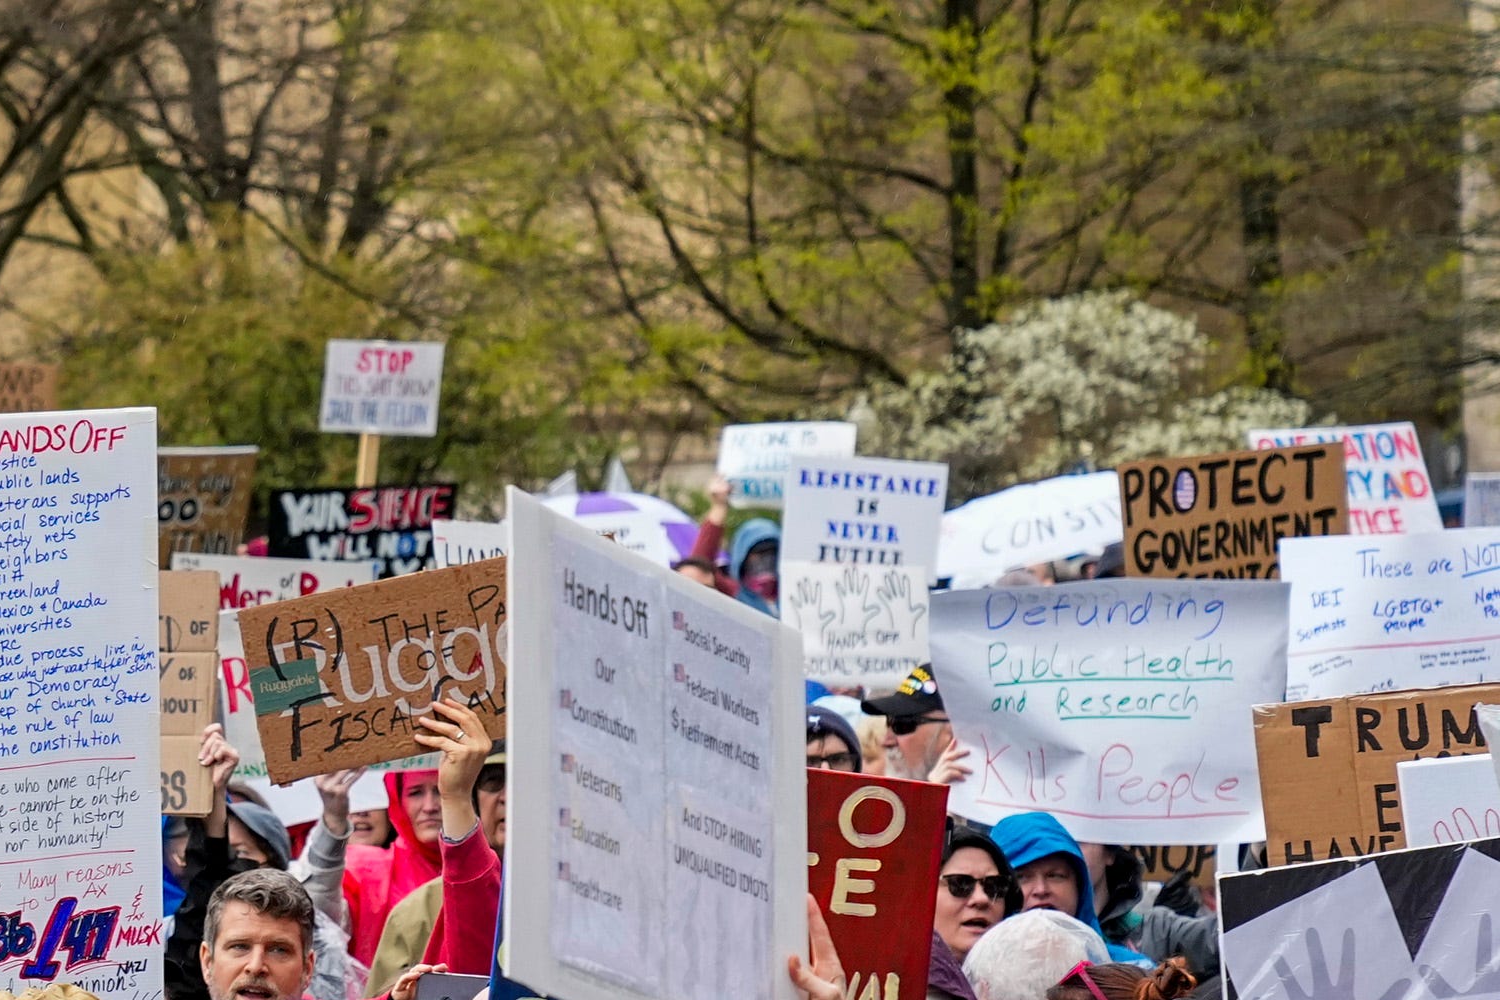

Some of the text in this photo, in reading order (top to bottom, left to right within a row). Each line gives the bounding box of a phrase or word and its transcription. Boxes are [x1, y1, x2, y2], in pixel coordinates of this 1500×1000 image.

[357, 348, 414, 374] STOP
[69, 419, 127, 454] OFF
[40, 467, 81, 486] lands
[799, 468, 941, 498] RESISTANCE
[1122, 449, 1327, 528] PROTECT
[70, 484, 131, 511] supports
[855, 498, 880, 517] IS
[279, 491, 350, 537] YOUR
[44, 527, 77, 544] nets
[378, 530, 432, 558] NOT
[826, 519, 901, 544] NEVER
[1133, 507, 1339, 574] GOVERNMENT
[1356, 548, 1413, 579] These
[1427, 558, 1455, 575] are
[279, 571, 297, 591] of
[53, 592, 108, 614] Canada
[564, 566, 649, 640] Hands Off
[1310, 587, 1345, 609] DEI
[1372, 599, 1445, 618] LGBTQ+
[189, 619, 211, 636] OF
[984, 590, 1227, 641] Defunding
[369, 610, 455, 653] THE
[827, 629, 901, 651] HANDS OFF
[31, 645, 85, 667] process
[416, 645, 456, 672] OF
[683, 622, 751, 675] Social Security
[987, 640, 1235, 682] Public Health
[178, 666, 198, 682] OR
[594, 656, 617, 684] Our
[856, 654, 922, 677] SECURITY
[27, 674, 121, 698] Democracy
[258, 672, 318, 694] Ruggable
[26, 698, 46, 715] of
[51, 694, 97, 712] church
[684, 673, 760, 727] Federal Workers
[990, 685, 1201, 715] and Research
[25, 718, 57, 734] rule
[64, 711, 83, 729] of
[90, 709, 115, 725] law
[570, 698, 638, 746] Constitution
[29, 729, 122, 755] constitution
[680, 718, 735, 760] Retirement
[14, 776, 41, 794] who
[46, 775, 77, 791] come
[86, 766, 132, 790] after
[574, 764, 623, 803] Veterans
[1097, 743, 1241, 818] People
[69, 793, 86, 810] be
[91, 795, 108, 808] on
[113, 787, 141, 808] the
[10, 813, 38, 834] side
[46, 813, 64, 831] of
[73, 807, 125, 830] history
[681, 806, 763, 859] And STOP HIRING
[5, 826, 110, 854] nor humanity!
[570, 820, 621, 856] Education
[17, 867, 58, 902] Many
[66, 861, 135, 884] reasons
[673, 845, 770, 903] UNQUALIFIED IDIOTS
[16, 896, 40, 914] to
[570, 872, 623, 913] Healthcare
[115, 923, 163, 948] MUSK
